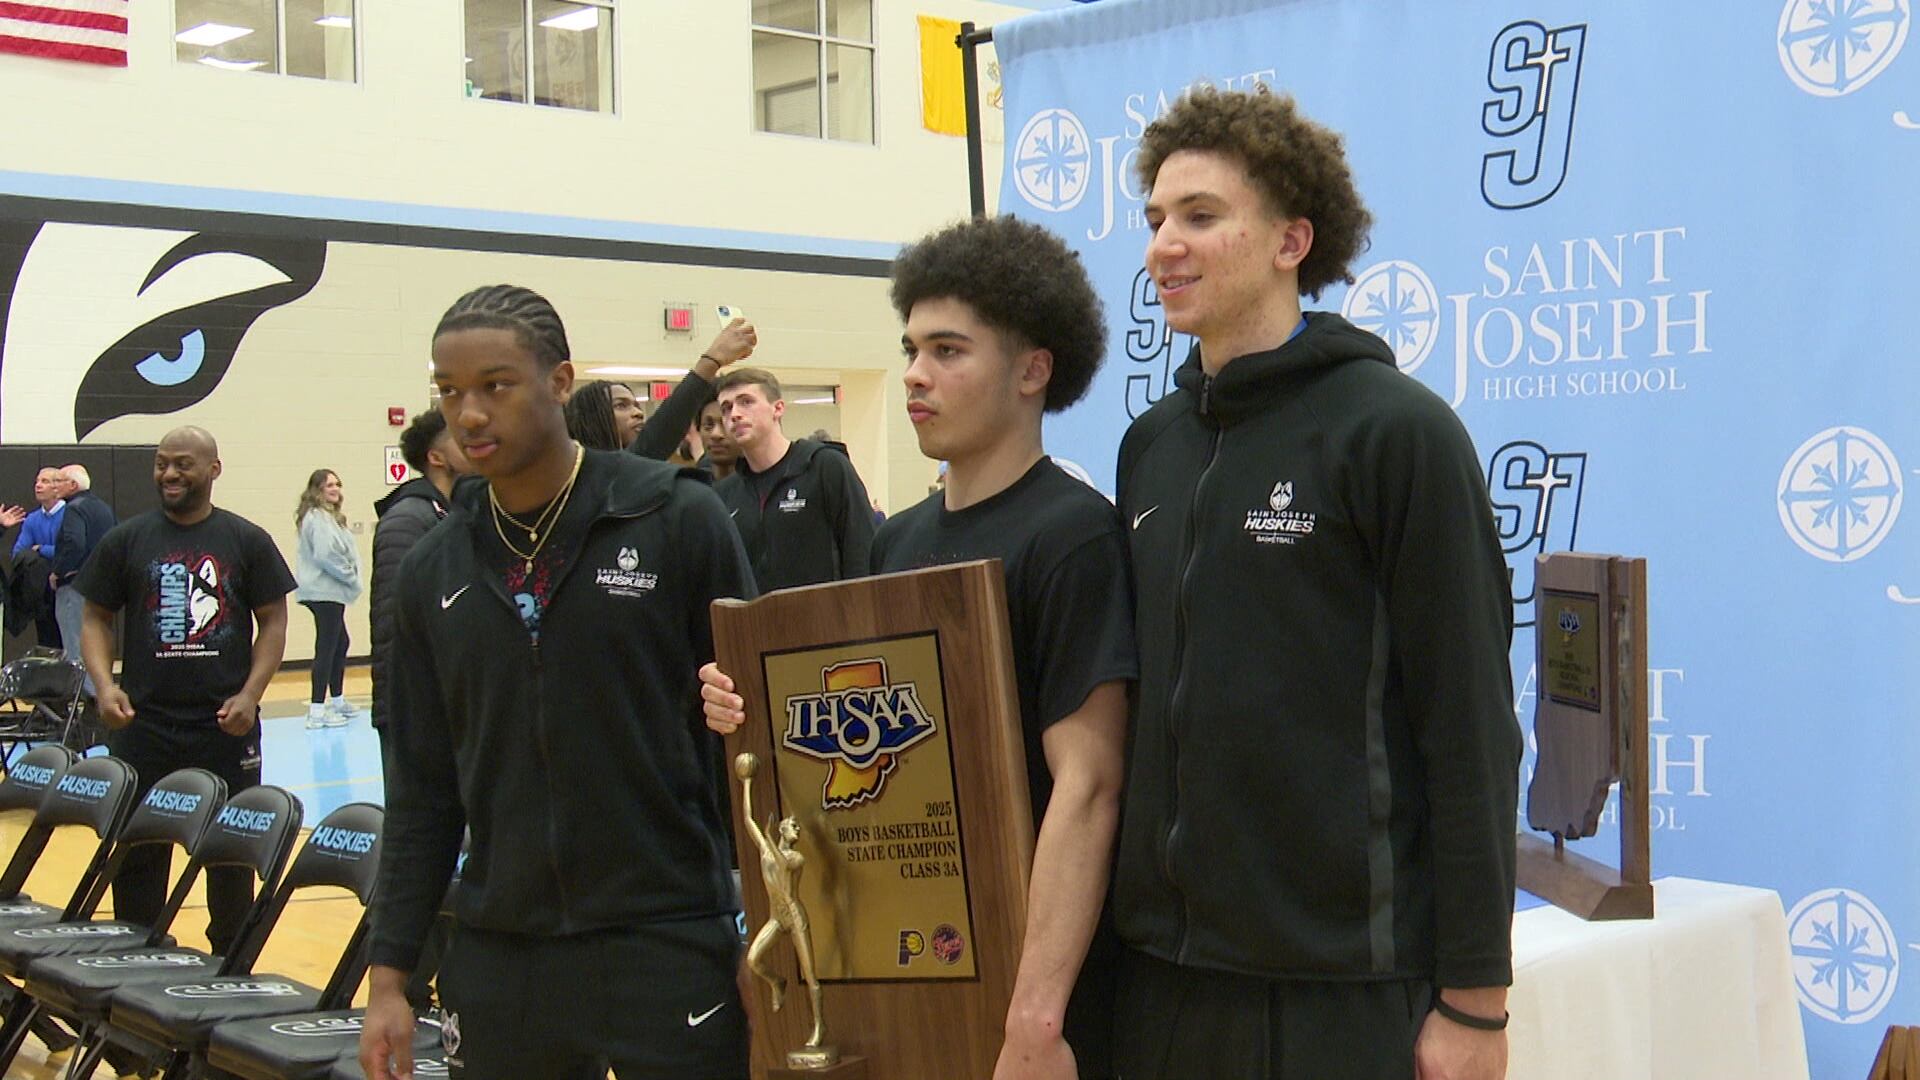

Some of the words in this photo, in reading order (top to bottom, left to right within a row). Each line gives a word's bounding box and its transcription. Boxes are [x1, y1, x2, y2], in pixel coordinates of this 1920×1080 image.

[1482, 226, 1686, 299] SAINT
[1446, 290, 1713, 409] JOSEPH
[1483, 374, 1557, 400] HIGH
[1566, 367, 1687, 396] SCHOOL
[1243, 517, 1315, 533] HUSKIES
[1246, 509, 1274, 518] SAINT
[1275, 511, 1316, 521] JOSEPH
[595, 574, 657, 589] HUSKIES
[160, 563, 186, 643] CHAMPS
[790, 688, 931, 756] IHSAA
[9, 762, 56, 785] HUSKIES
[56, 774, 112, 798] HUSKIES
[145, 788, 203, 813] HUSKIES
[925, 801, 952, 817] 2025
[217, 806, 277, 832] HUSKIES
[309, 825, 377, 853] HUSKIES
[837, 826, 870, 843] BOYS
[873, 821, 955, 840] BASKETBALL
[847, 845, 886, 862] STATE
[888, 841, 957, 860] CHAMPION
[900, 862, 941, 879] CLASS
[943, 861, 960, 878] 3A
